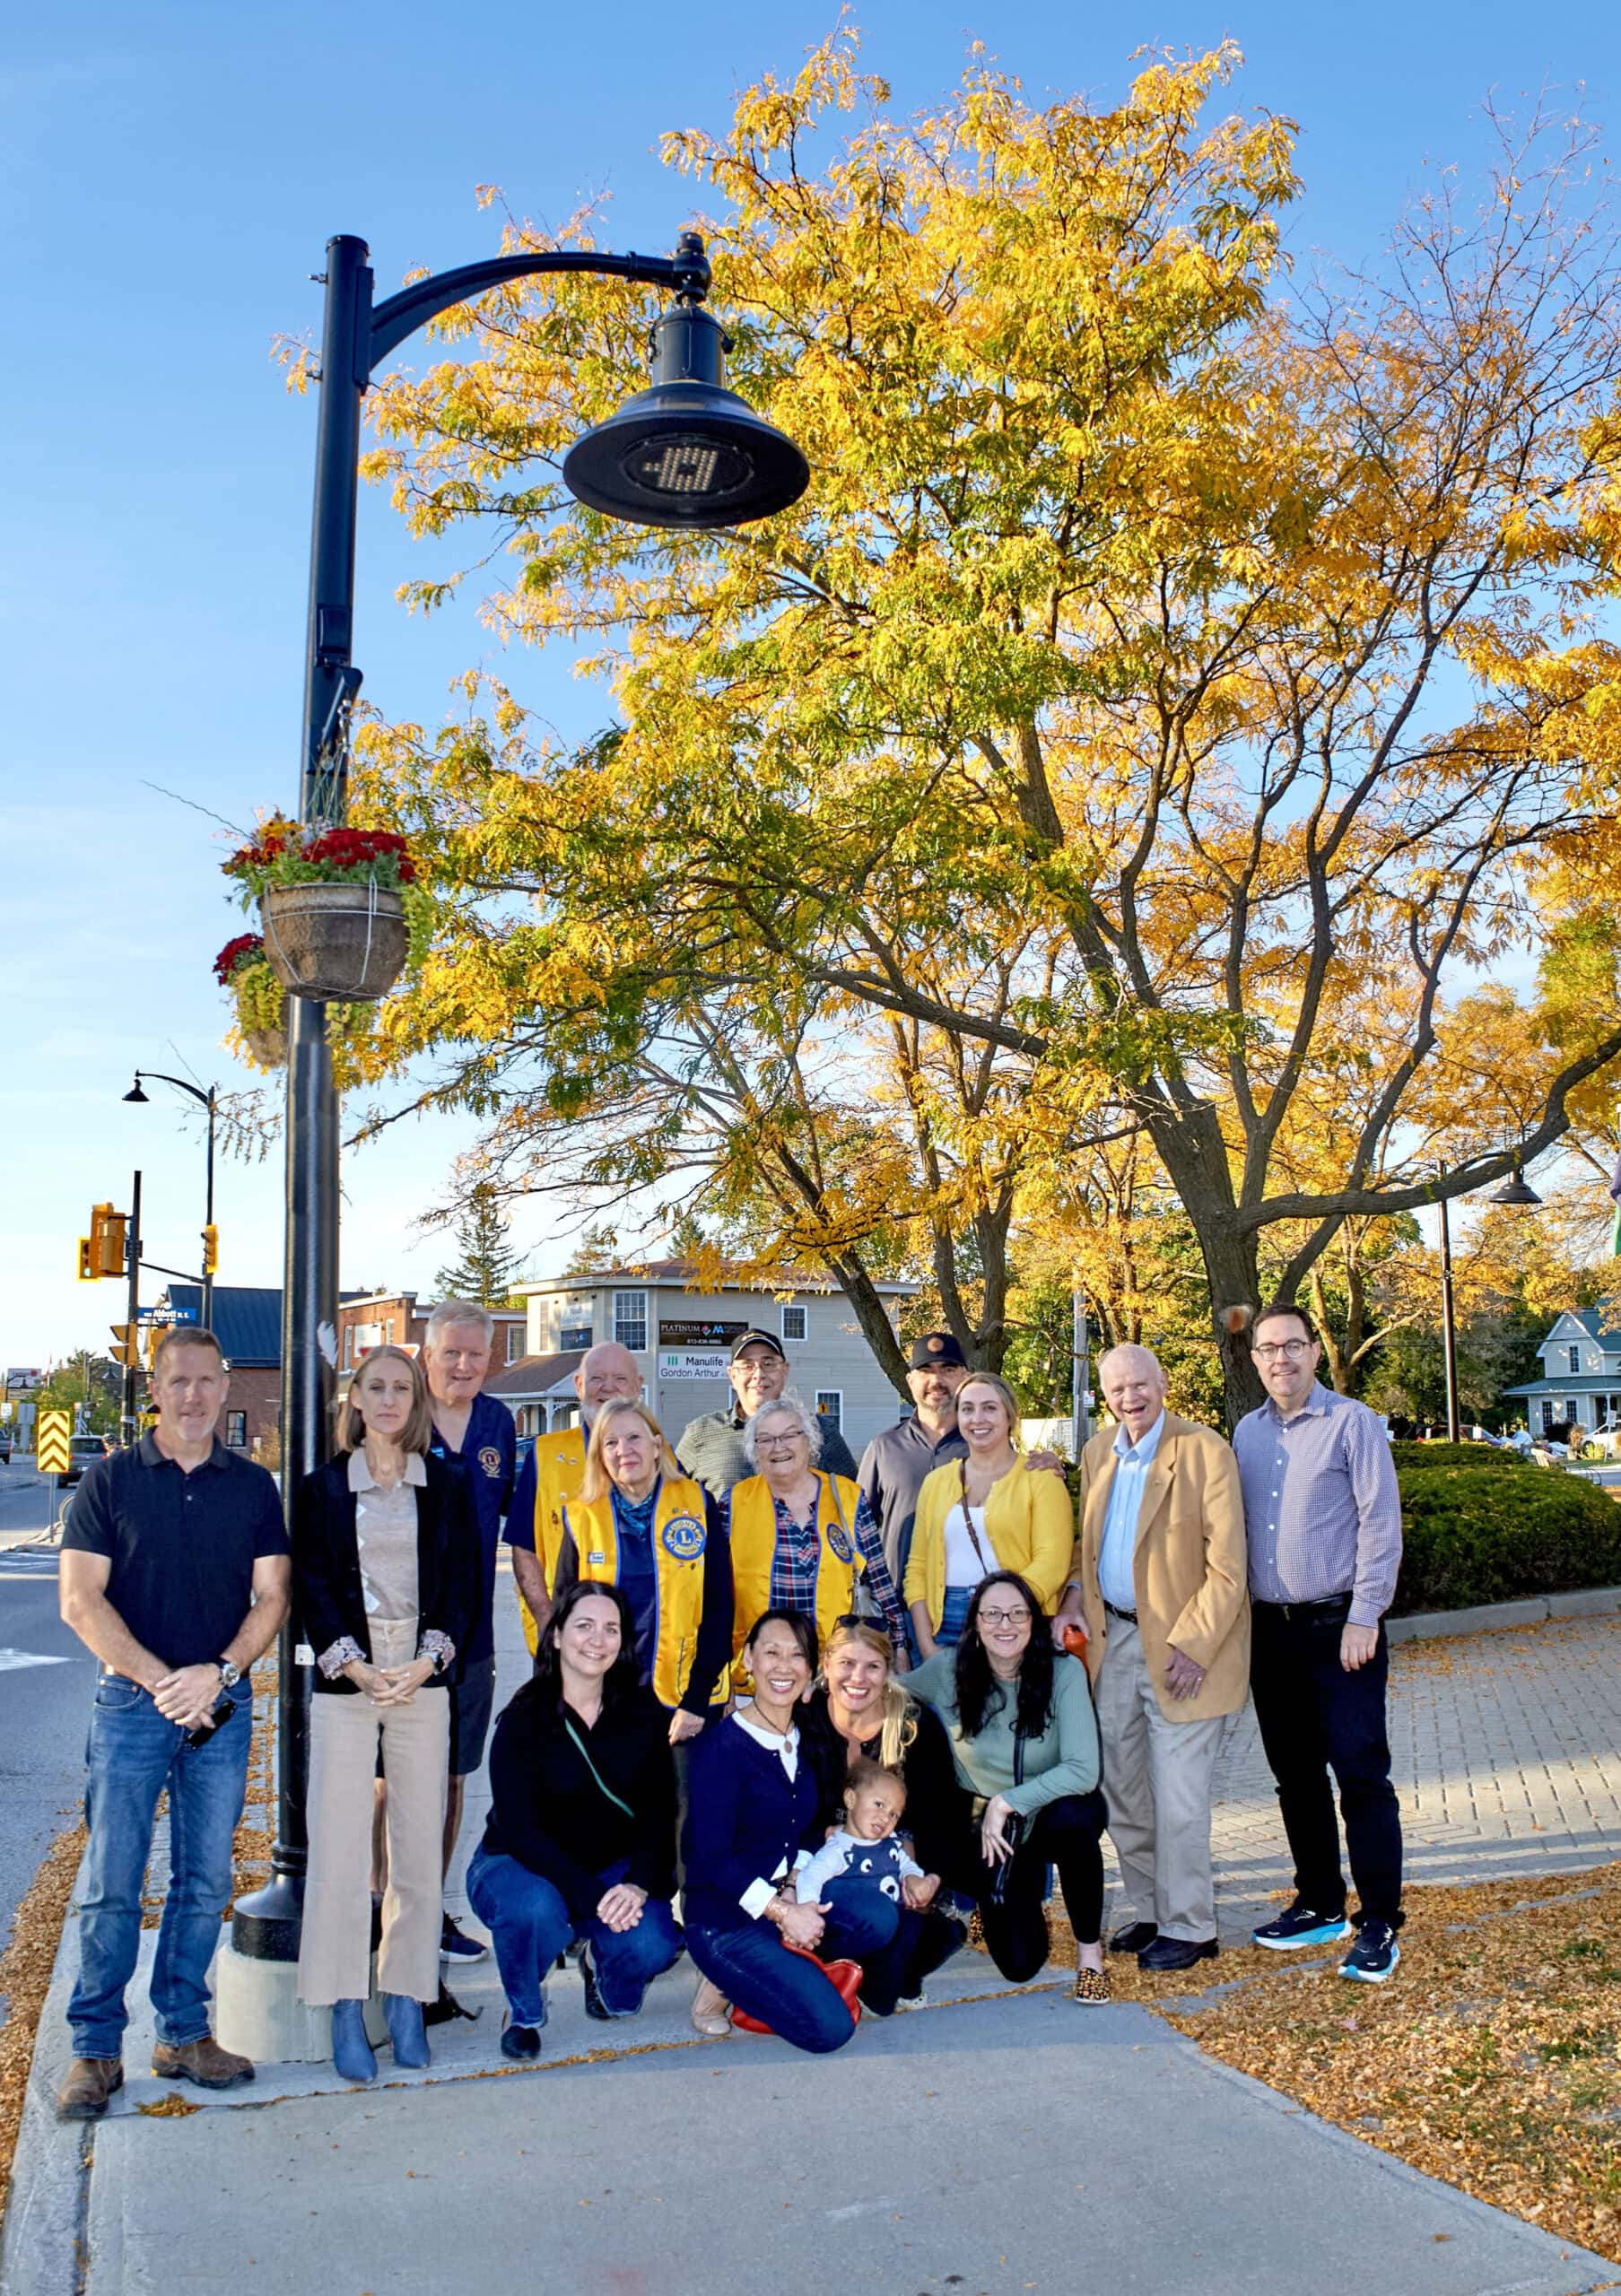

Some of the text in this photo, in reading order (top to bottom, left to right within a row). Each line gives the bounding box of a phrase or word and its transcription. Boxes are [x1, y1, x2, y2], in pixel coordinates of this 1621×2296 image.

[153, 1309, 176, 1318] Abbott
[685, 1356, 723, 1366] Manulife
[660, 1368, 692, 1378] Gordon
[694, 1368, 719, 1378] Arthur
[681, 1531, 692, 1543] L
